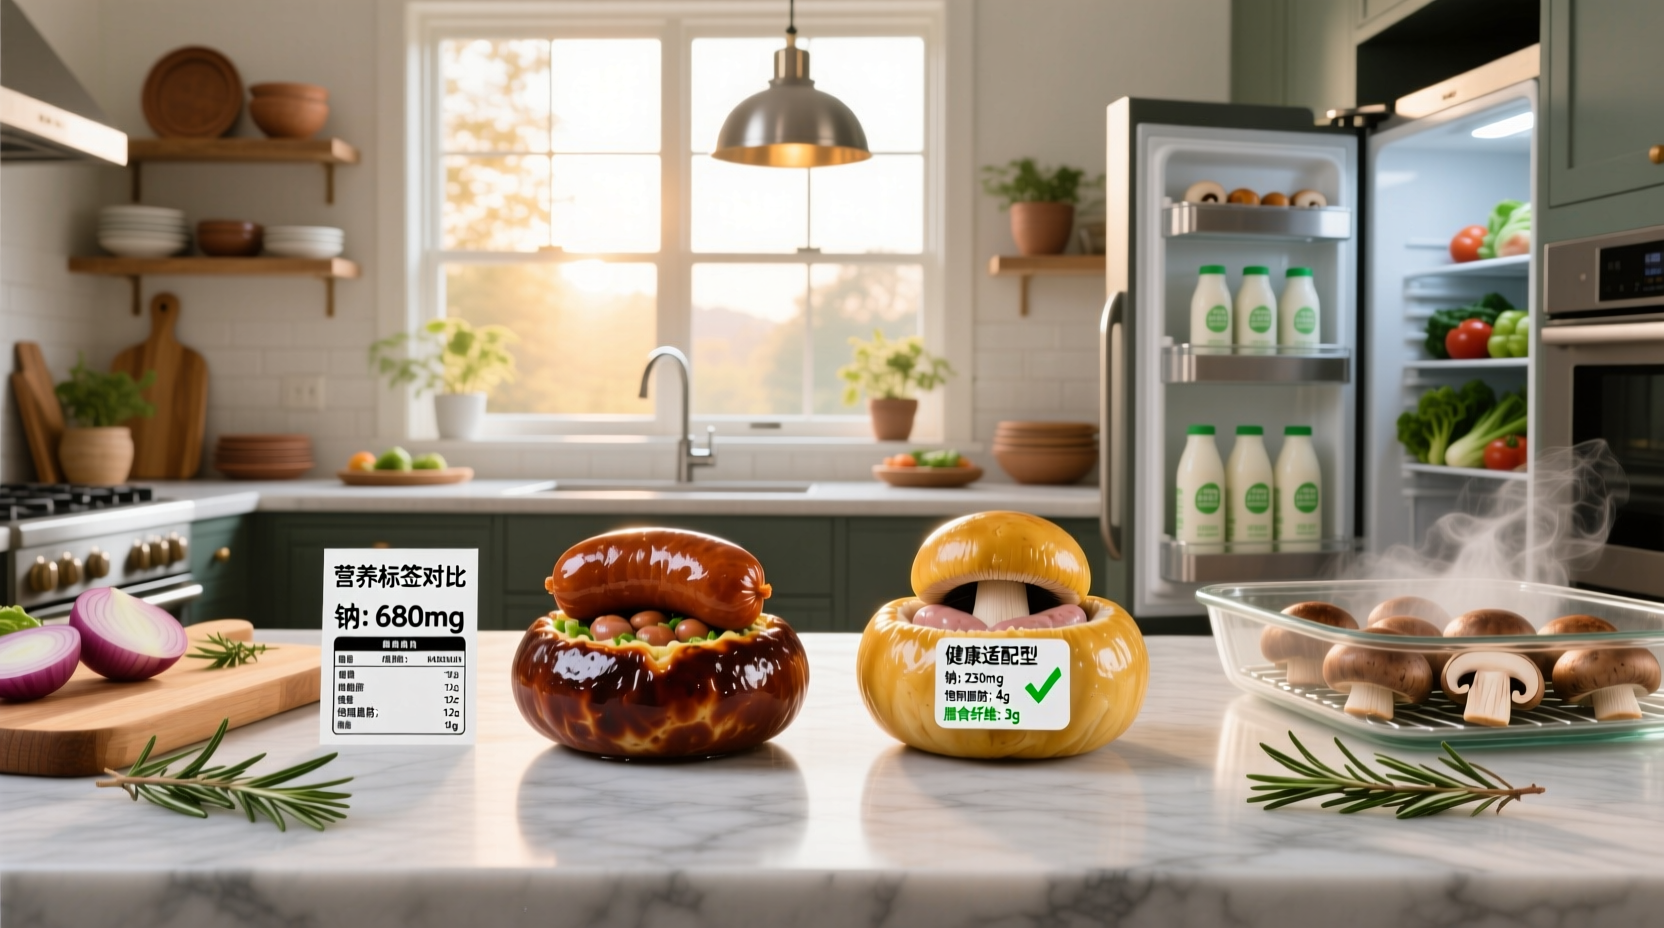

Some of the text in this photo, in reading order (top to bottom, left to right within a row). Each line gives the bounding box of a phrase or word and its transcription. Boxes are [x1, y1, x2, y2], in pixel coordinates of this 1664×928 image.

[334, 564, 467, 588] 营养标签对比
[375, 604, 464, 634] 680mg
[945, 644, 1038, 666] 健康适配型
[964, 672, 1004, 687] 230mg
[996, 689, 1010, 704] 4g
[1004, 708, 1020, 725] 3g
